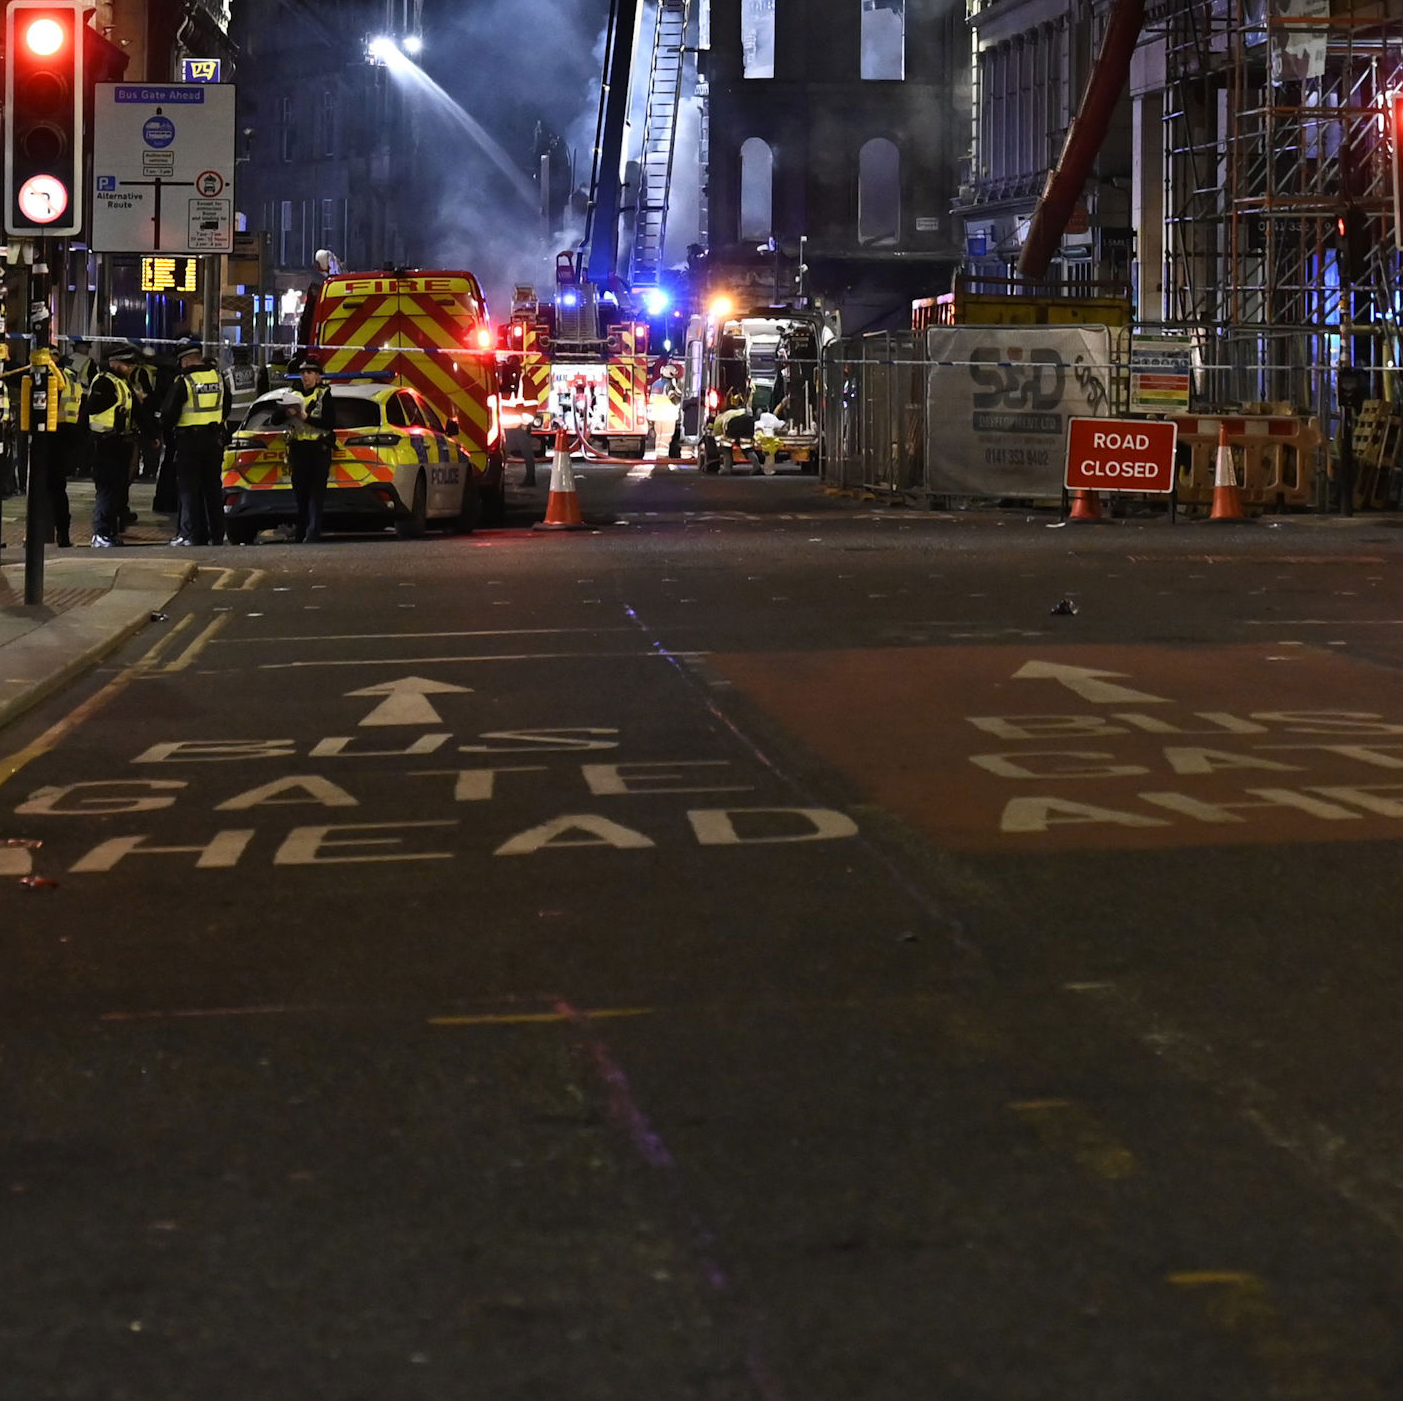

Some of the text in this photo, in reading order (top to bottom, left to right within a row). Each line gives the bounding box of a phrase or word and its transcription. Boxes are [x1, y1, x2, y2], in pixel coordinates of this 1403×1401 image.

[118, 89, 201, 100] Bus Gate Ahead
[97, 192, 143, 200] Alternative
[108, 201, 133, 209] Route
[345, 280, 452, 293] FIRE
[196, 382, 221, 394] POLICE
[1092, 432, 1150, 450] ROAD
[431, 467, 459, 485] POLICE
[1080, 459, 1159, 478] CLOSED
[130, 727, 620, 764] BUS
[12, 759, 756, 817] GATE
